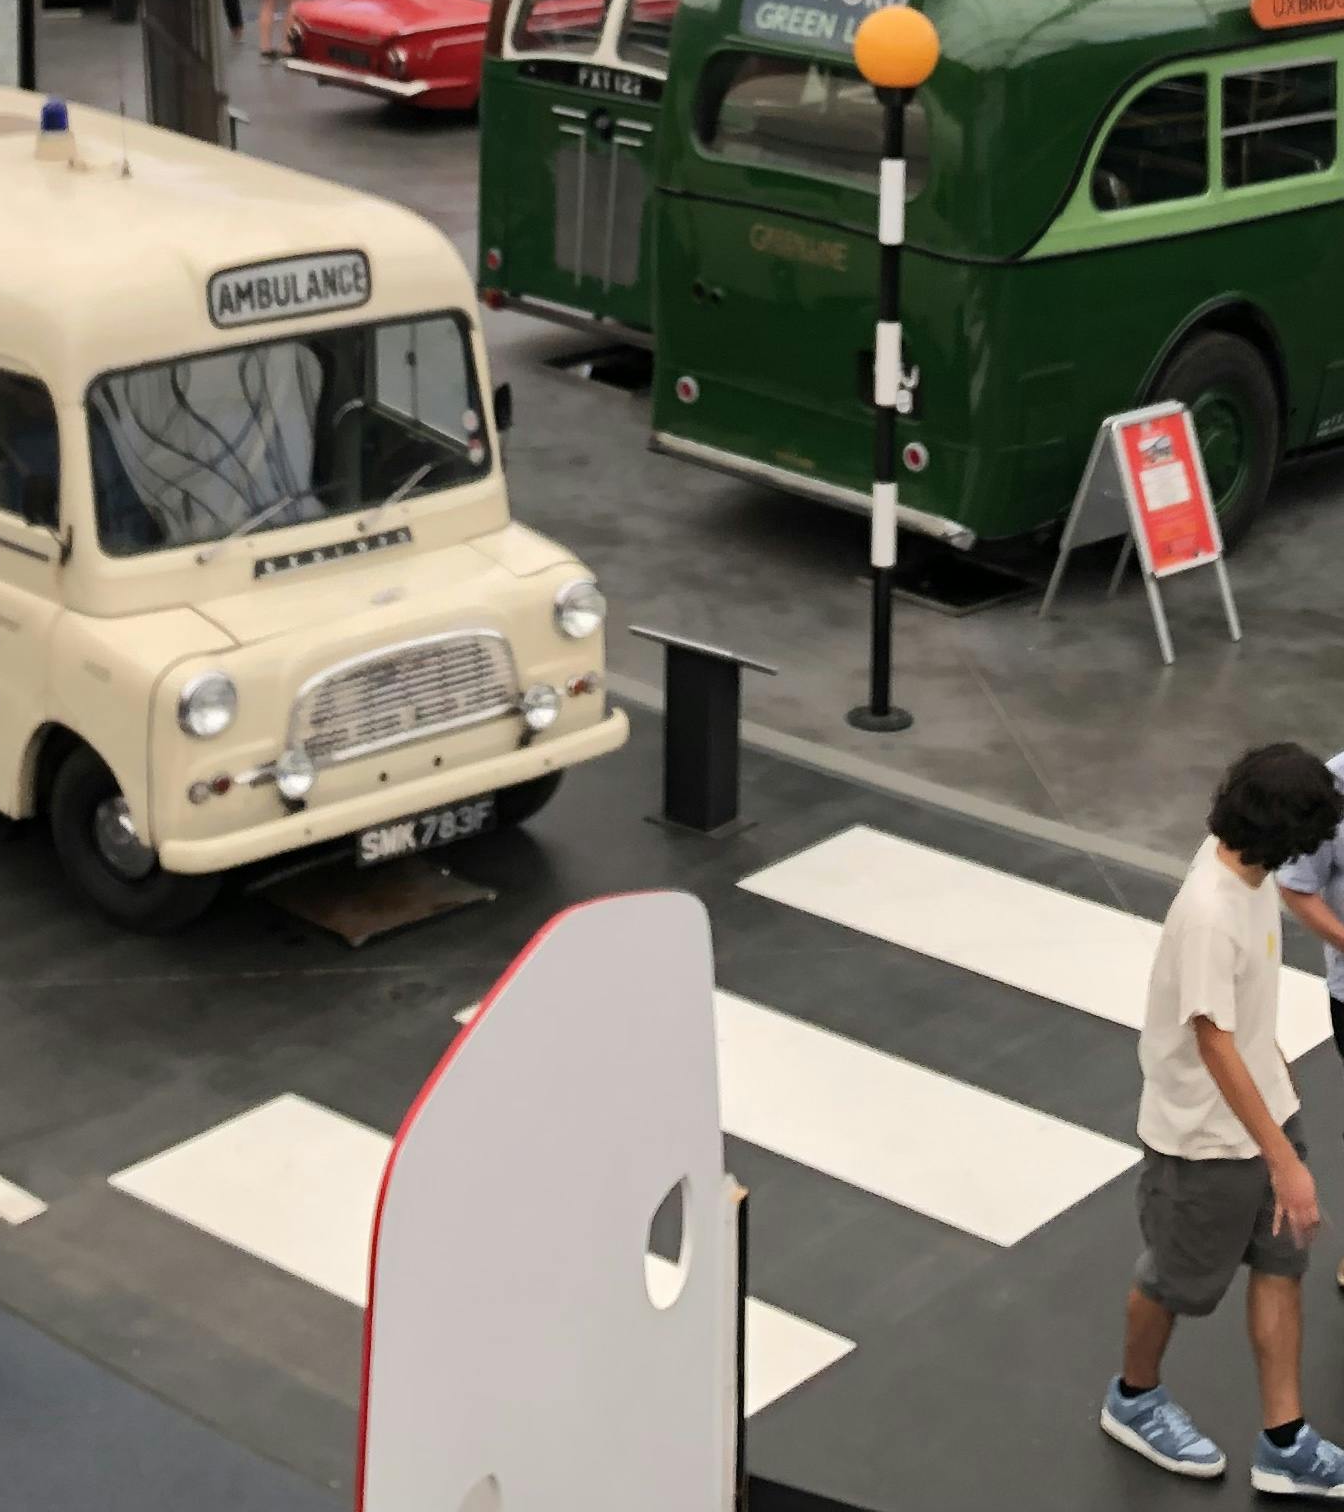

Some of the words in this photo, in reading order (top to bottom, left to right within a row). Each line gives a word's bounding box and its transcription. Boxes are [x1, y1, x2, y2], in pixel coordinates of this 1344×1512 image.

[756, 1, 839, 39] GREEN
[218, 261, 367, 316] AMBULANCE
[360, 821, 416, 861] SMK
